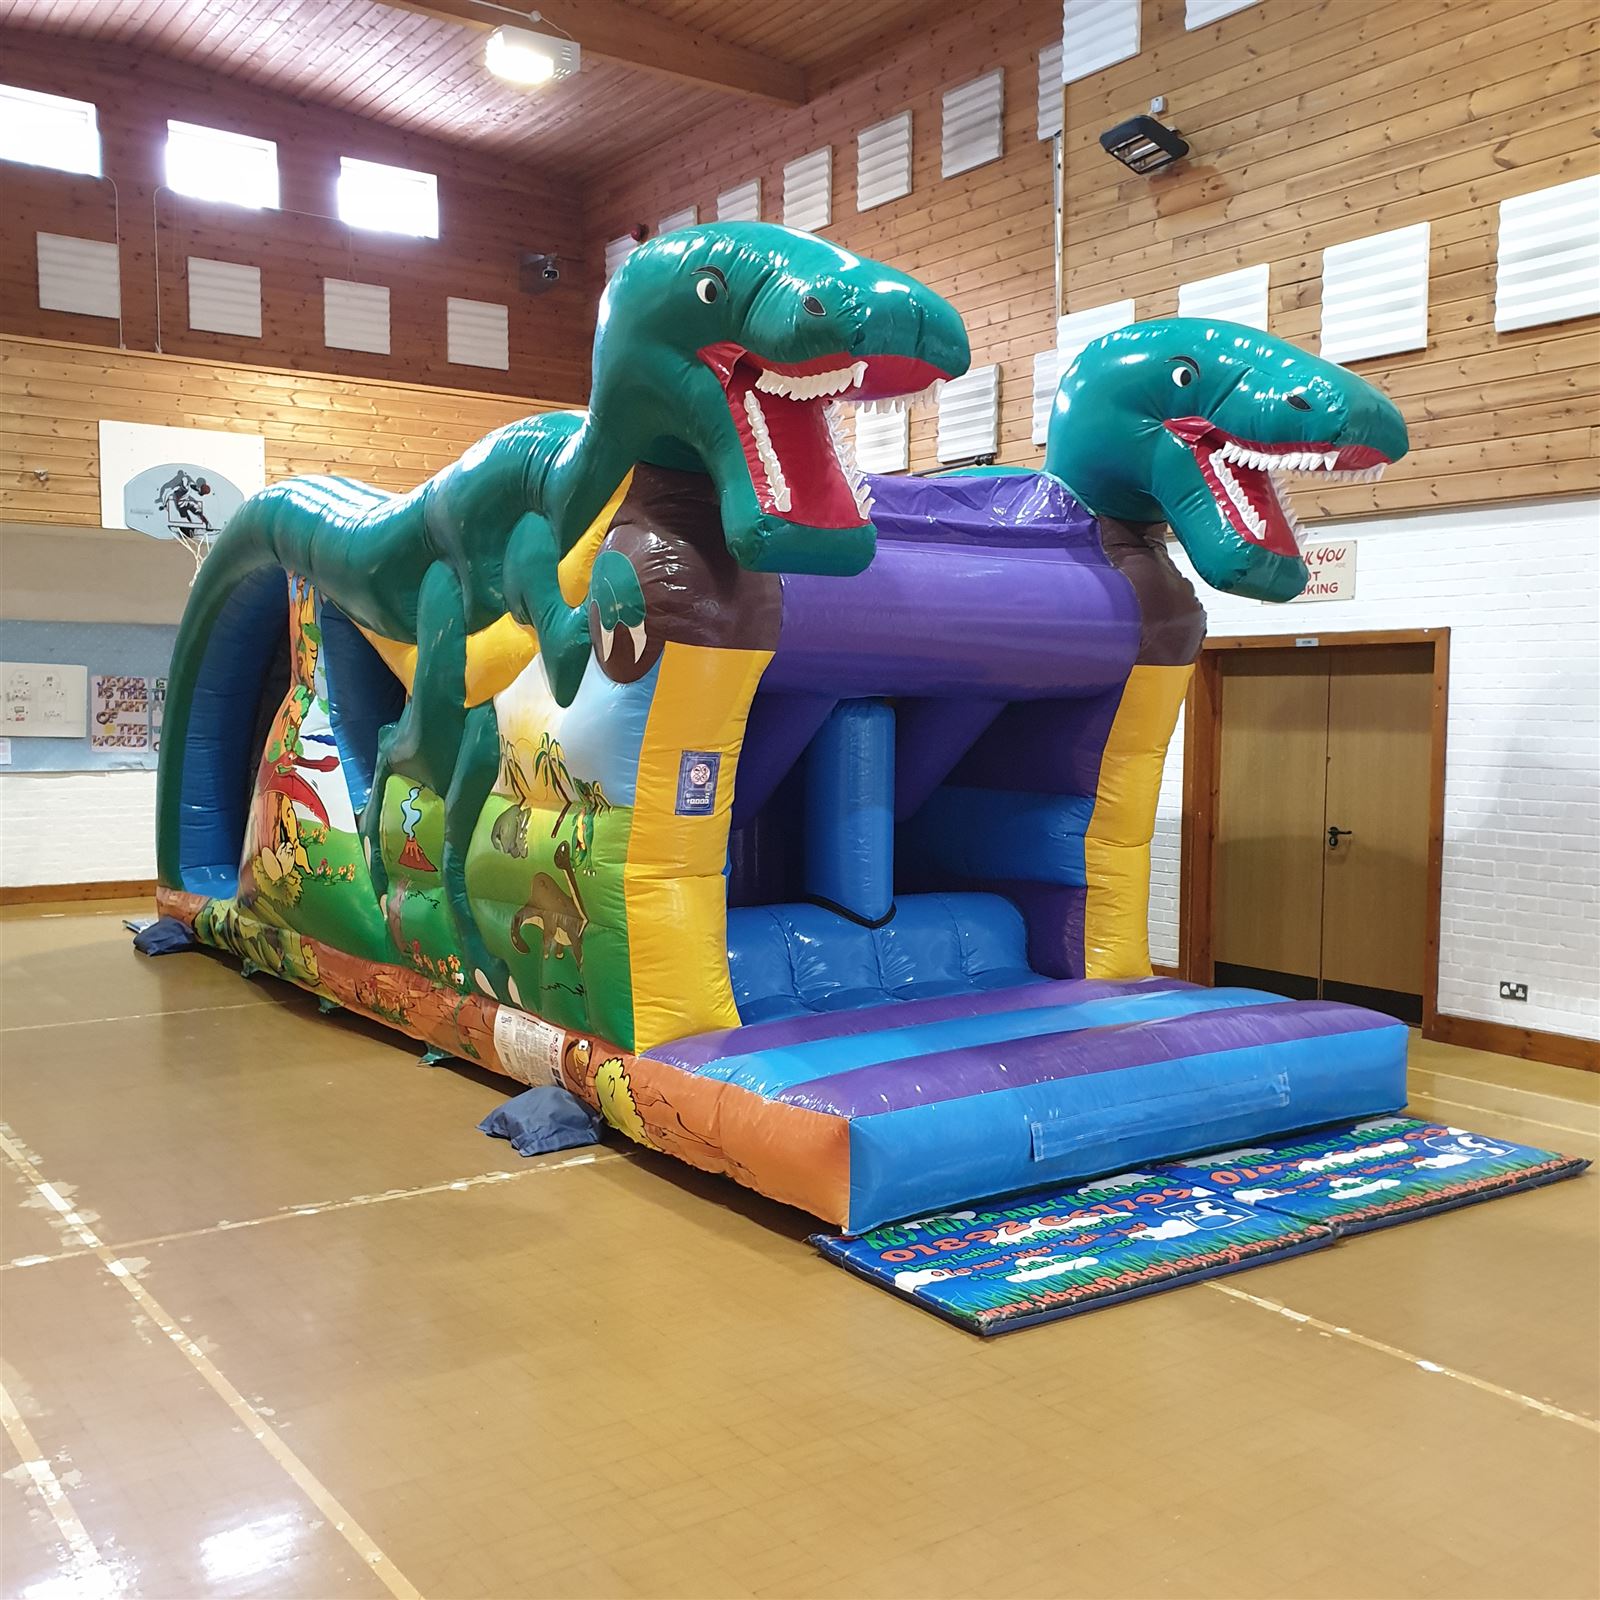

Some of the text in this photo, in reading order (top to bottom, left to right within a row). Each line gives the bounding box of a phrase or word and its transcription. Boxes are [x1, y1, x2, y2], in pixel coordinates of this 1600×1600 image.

[1316, 548, 1346, 565] YOU
[98, 686, 148, 699] IS THE
[105, 700, 148, 712] LIGHT
[117, 724, 147, 735] THE
[92, 735, 147, 747] WORLD
[862, 1176, 1180, 1250] KBS INFLAABLE KINGDOM
[880, 1221, 1032, 1262] 01892
